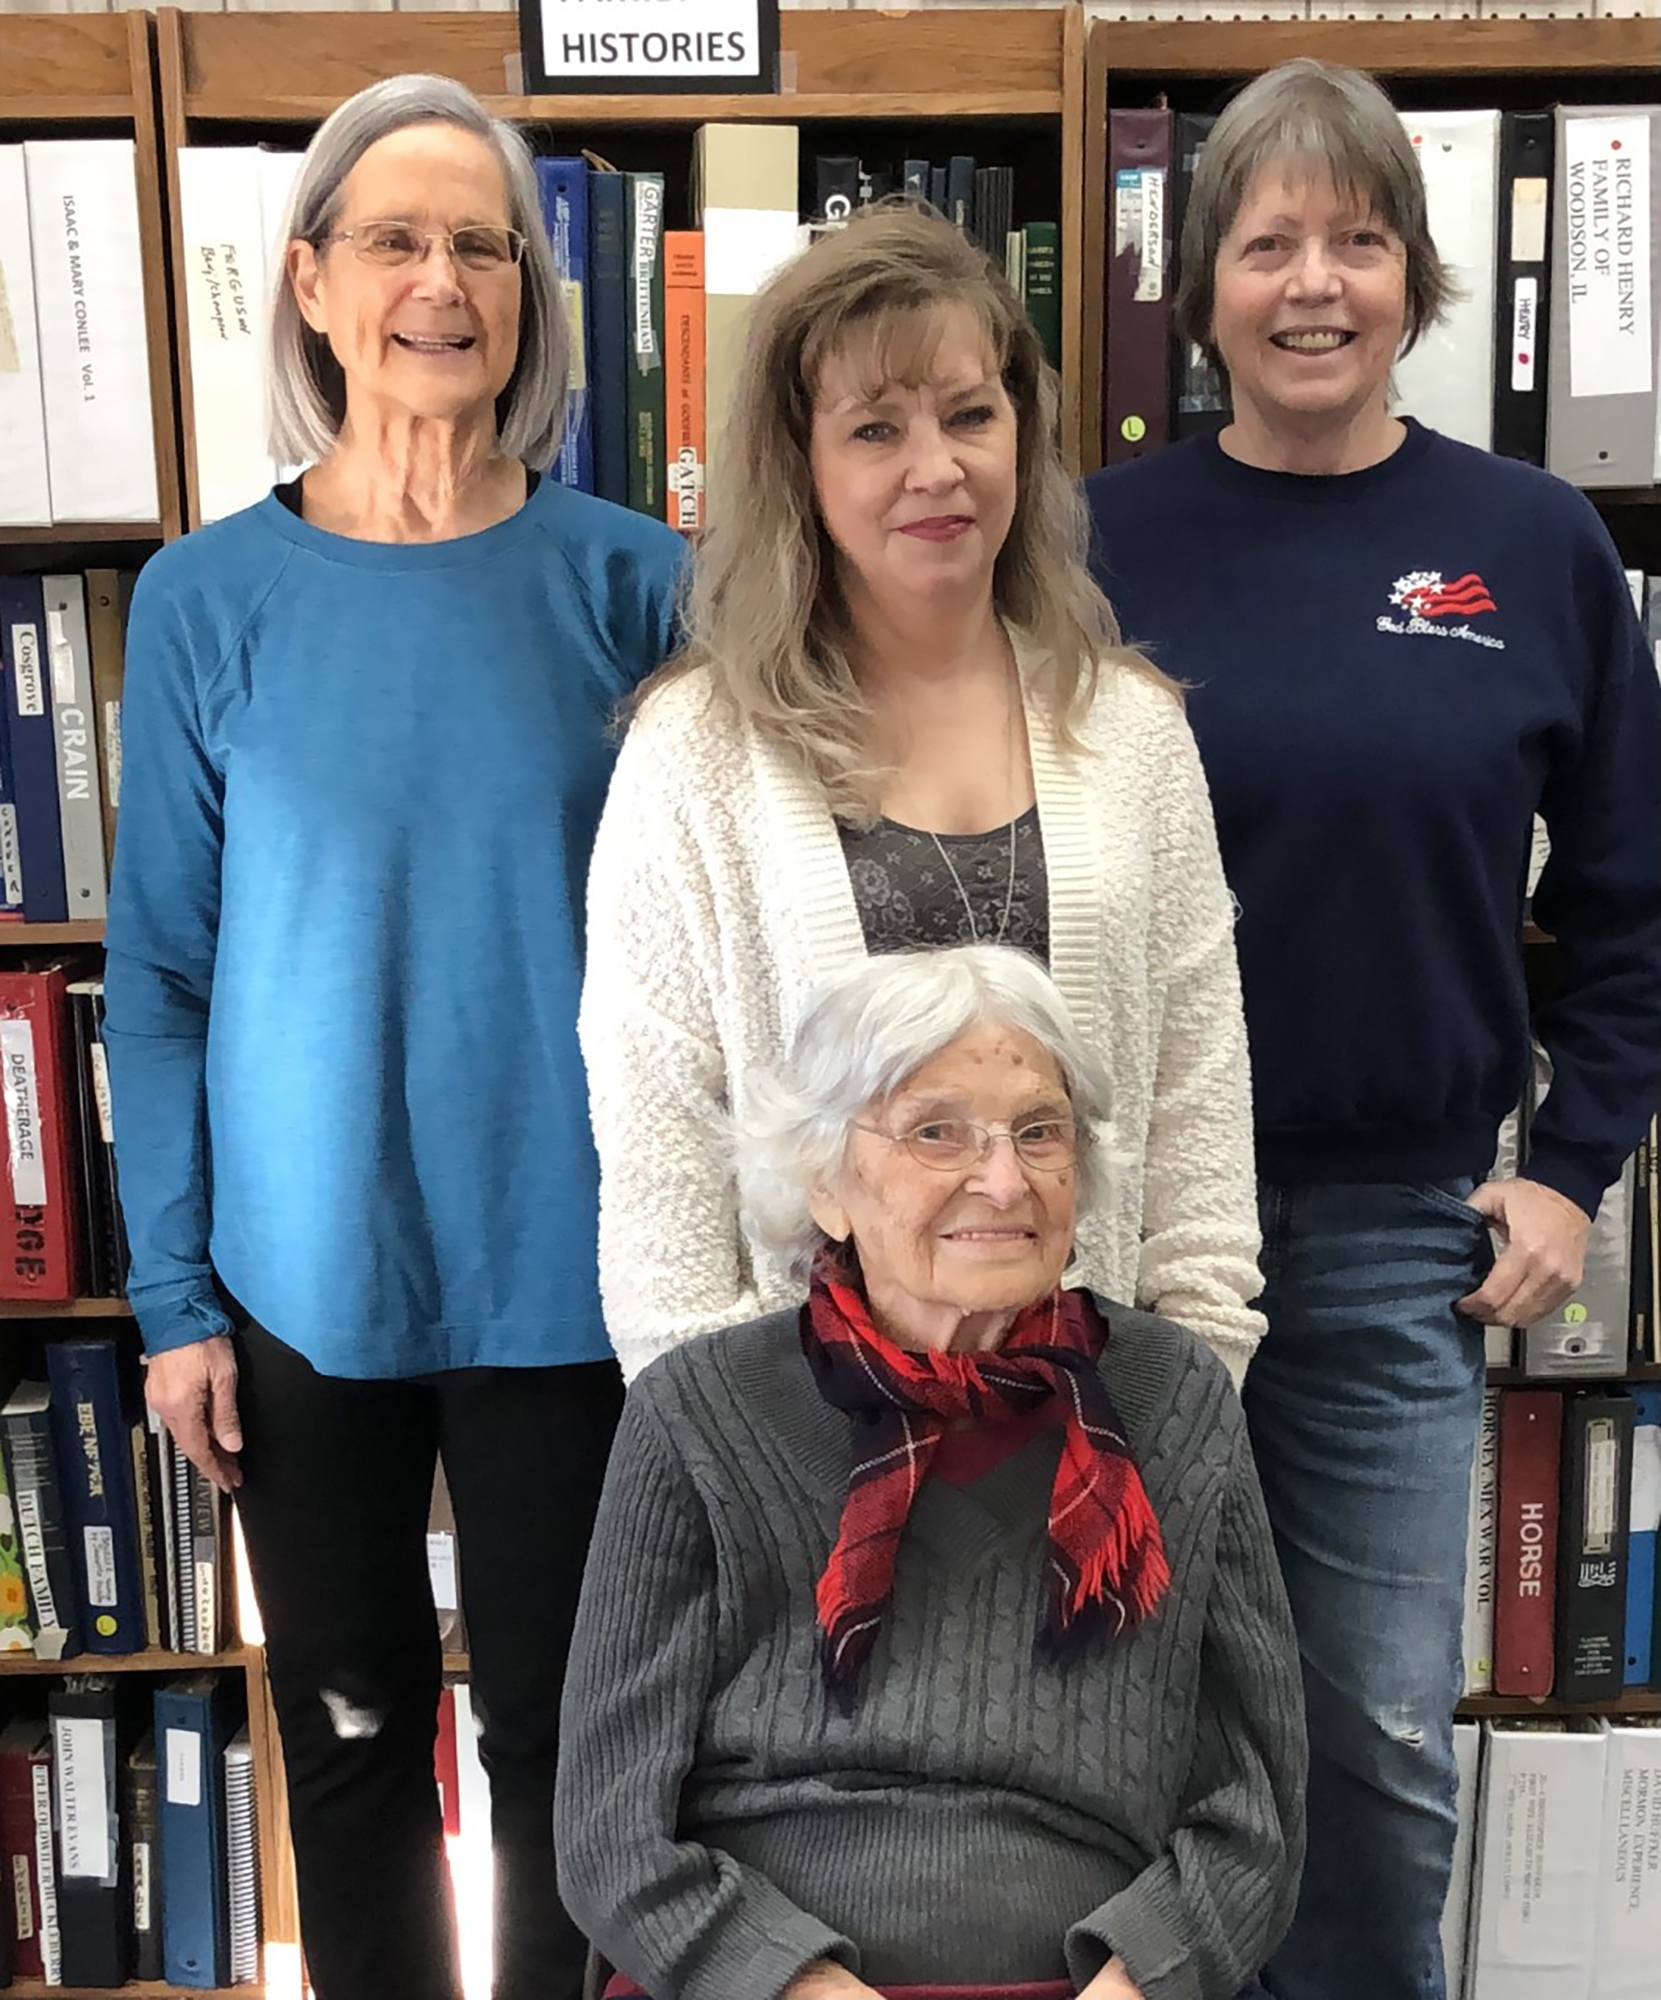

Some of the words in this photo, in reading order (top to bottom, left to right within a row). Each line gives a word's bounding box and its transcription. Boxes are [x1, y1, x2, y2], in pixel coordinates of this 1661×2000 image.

[562, 31, 746, 63] HISTORIES
[62, 195, 79, 237] ISAAC
[1592, 158, 1609, 242] FAMILY
[1615, 157, 1633, 257] RICHARD
[67, 240, 80, 251] &
[1594, 247, 1610, 278] OF
[69, 255, 85, 297] MARY
[1571, 282, 1588, 304] IL
[1618, 260, 1635, 336] HENRY
[74, 299, 91, 353] CONLEE
[1517, 297, 1532, 341] HENRY
[81, 363, 95, 391] Vol.
[1127, 421, 1138, 438] L
[679, 448, 697, 525] GATCH
[1376, 615, 1404, 633] God
[1405, 617, 1448, 637] Bless
[1450, 624, 1505, 650] America
[19, 631, 37, 713] Cosgrove
[60, 707, 90, 801] CRAIN
[11, 1053, 34, 1161] DEATHERAGE
[18, 1493, 43, 1557] DUTCH
[1479, 1523, 1493, 1567] WAR
[1519, 1502, 1543, 1598] HORSE
[29, 1563, 57, 1629] FAMILY
[60, 1725, 74, 1761] JOHN
[63, 1765, 77, 1824] WALTER
[1634, 1768, 1650, 1828] MORMON
[65, 1825, 80, 1869] EVANS
